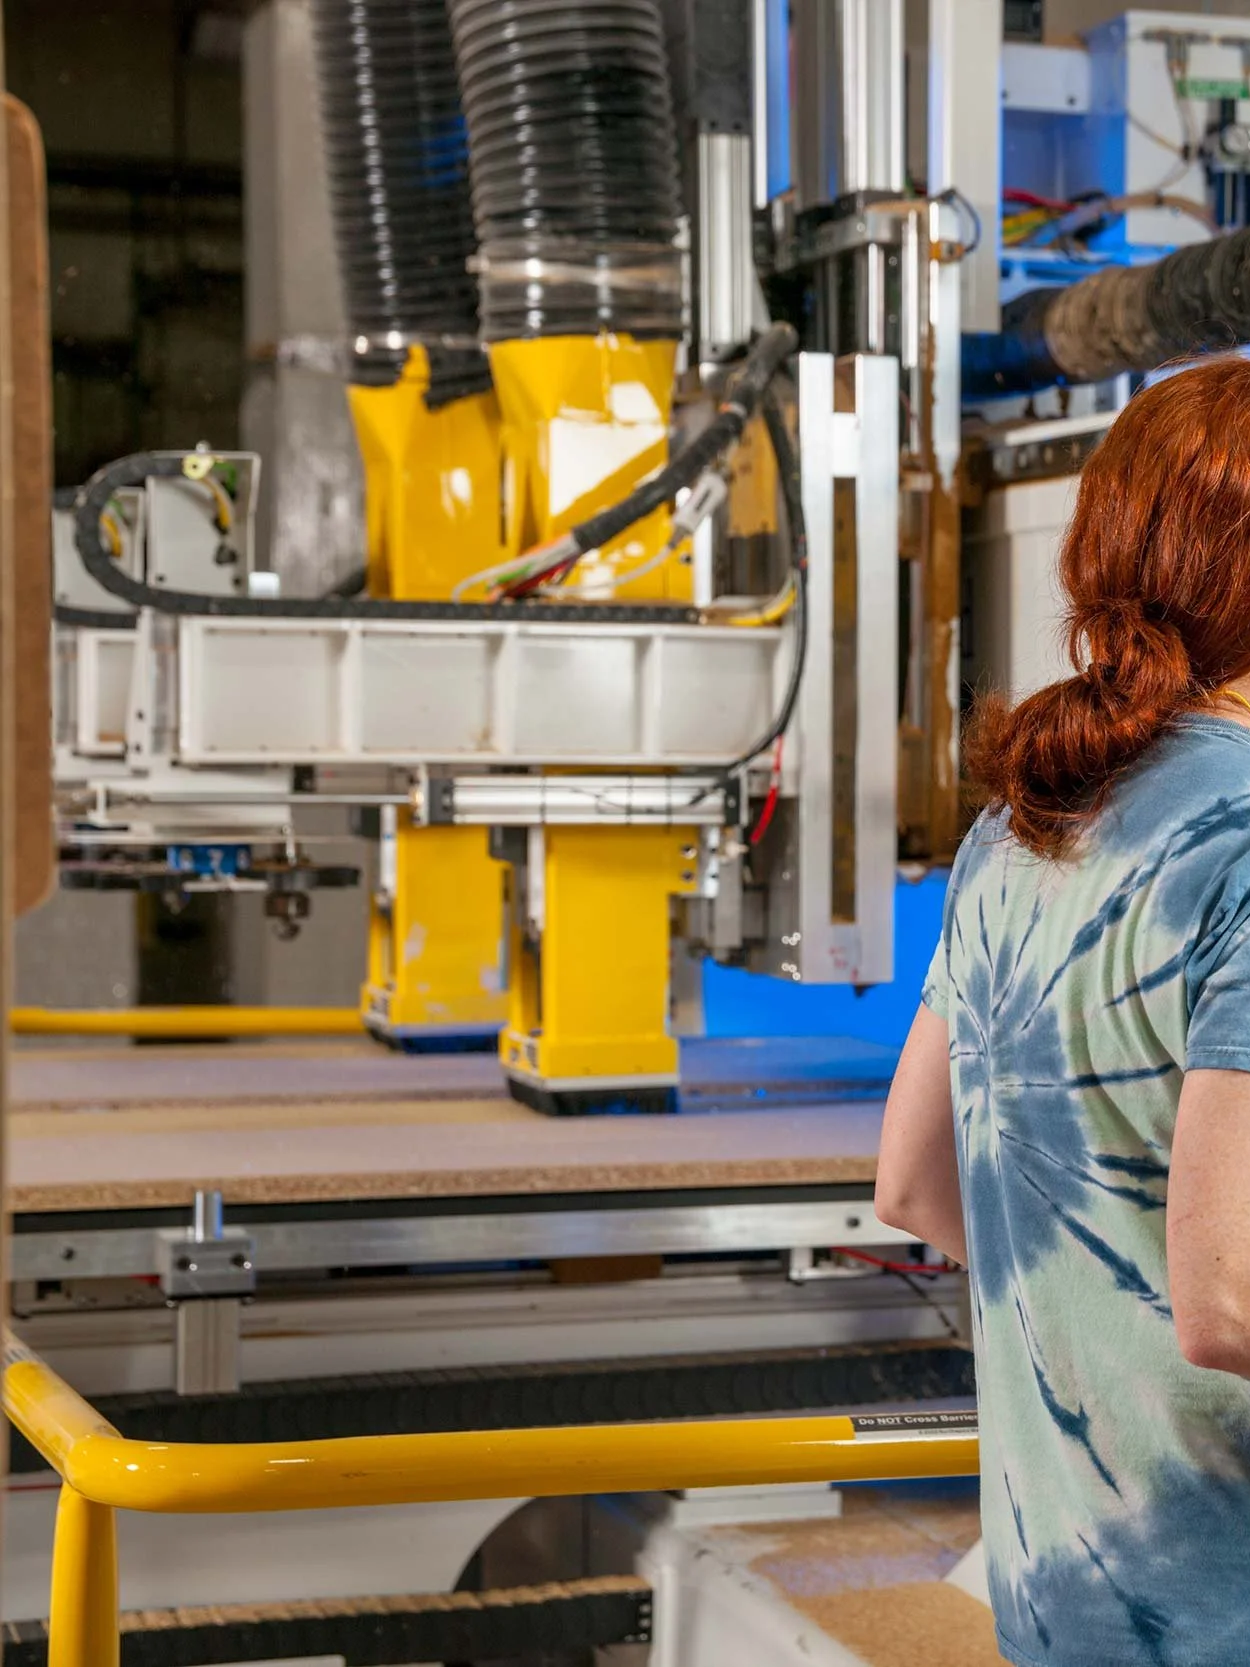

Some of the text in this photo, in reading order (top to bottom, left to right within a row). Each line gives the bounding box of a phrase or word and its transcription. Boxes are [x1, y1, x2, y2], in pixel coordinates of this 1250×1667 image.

[859, 1418, 875, 1426] Do
[878, 1416, 902, 1426] NOT
[904, 1415, 938, 1424] Cross
